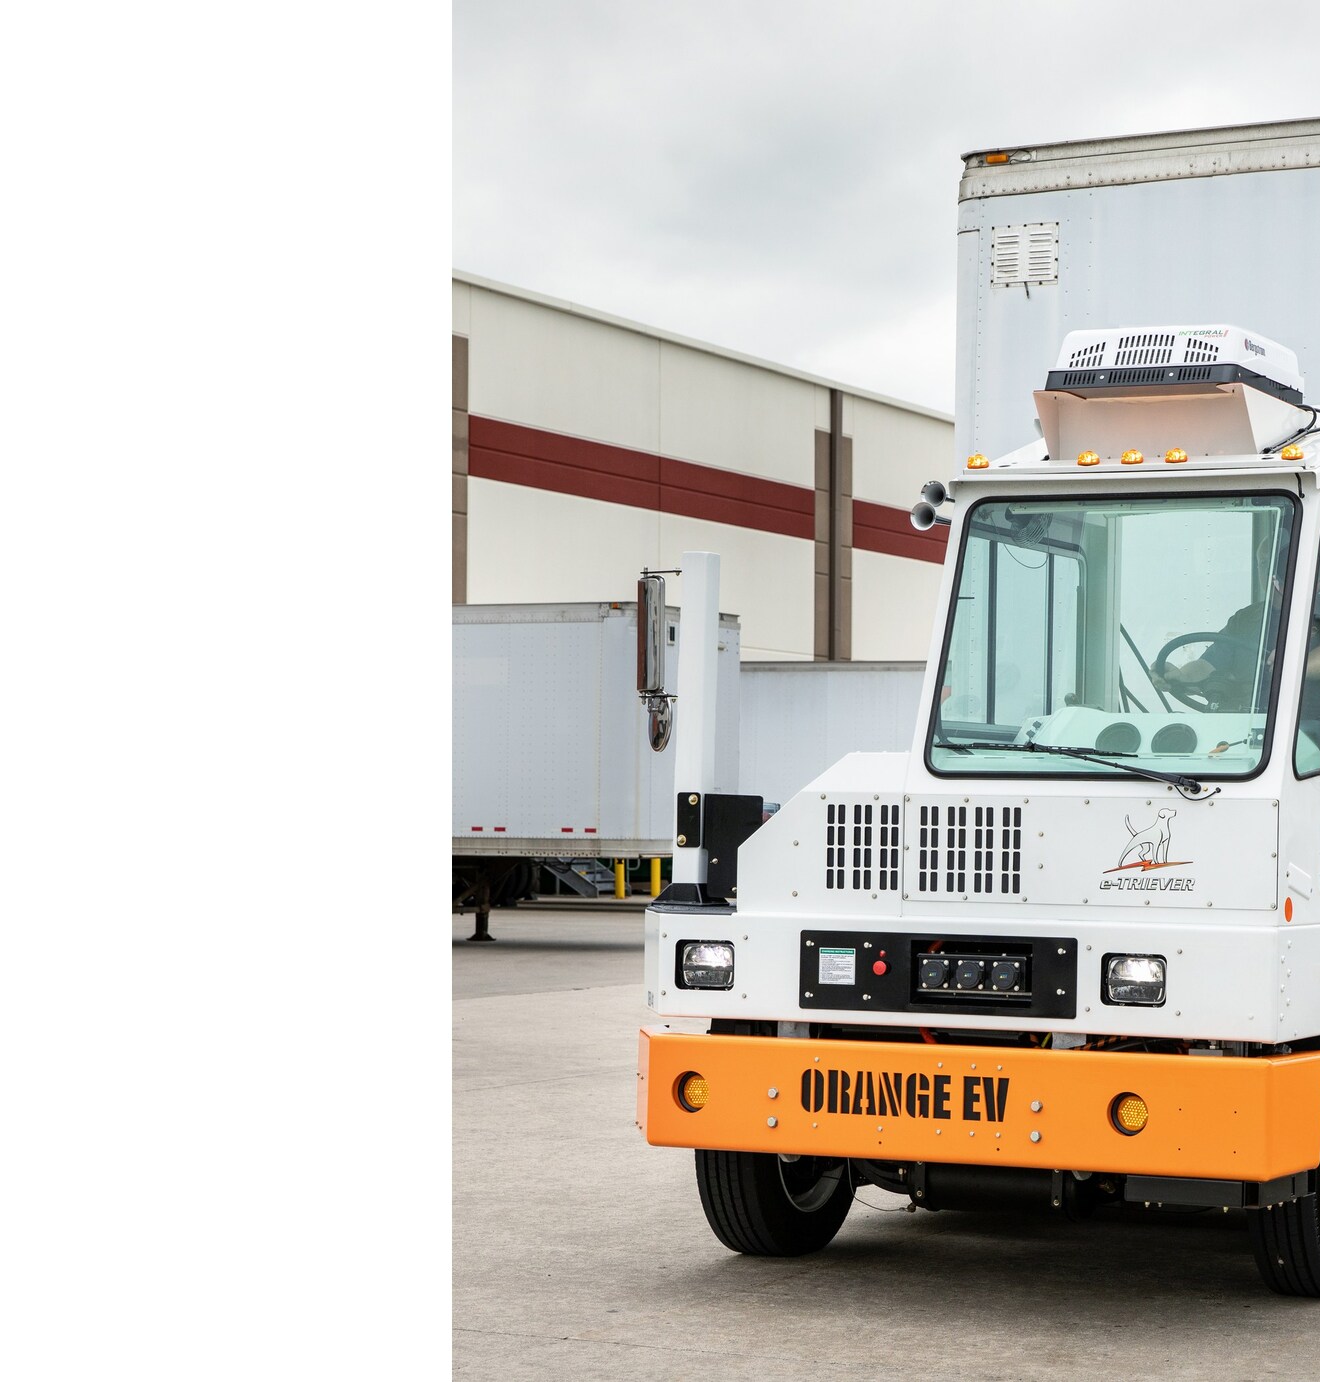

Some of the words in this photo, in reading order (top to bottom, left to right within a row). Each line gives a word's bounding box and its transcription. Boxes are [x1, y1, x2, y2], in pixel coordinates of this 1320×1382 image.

[1100, 877, 1196, 891] e-TRIEVER
[801, 1068, 951, 1120] ORANGE
[963, 1076, 1010, 1123] EV
